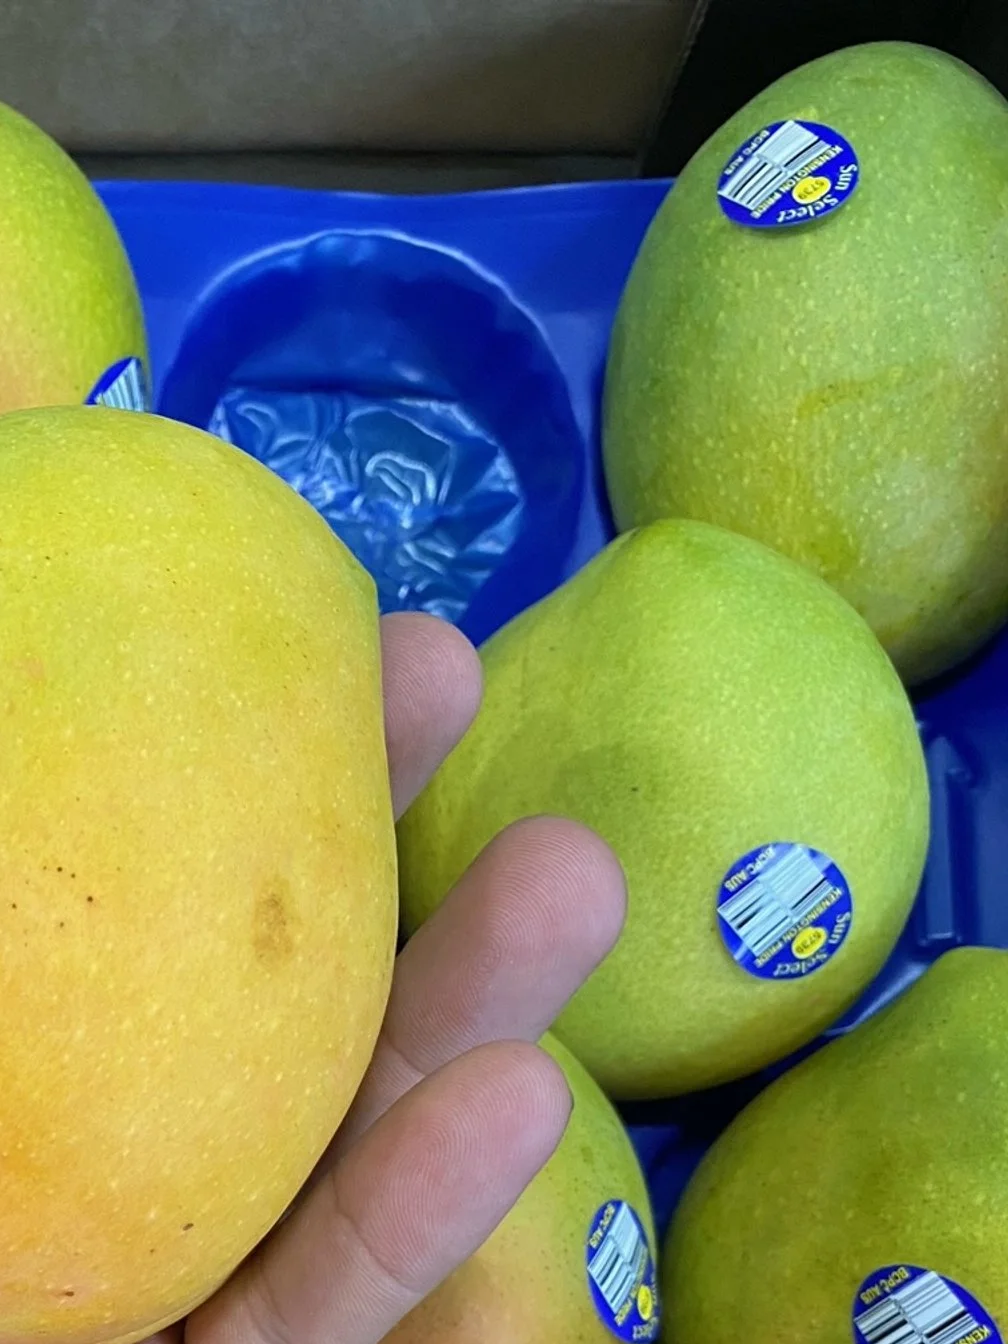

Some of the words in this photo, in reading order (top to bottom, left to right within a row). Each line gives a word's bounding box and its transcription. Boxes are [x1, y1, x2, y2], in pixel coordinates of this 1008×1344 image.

[780, 145, 844, 193] KENSINGTON
[835, 163, 858, 191] Sun
[750, 192, 782, 219] PRIDE
[777, 193, 839, 223] Select
[828, 912, 851, 944] Sun
[773, 948, 828, 976] Select
[880, 1267, 909, 1293] BCPC
[860, 1285, 881, 1304] AUS
